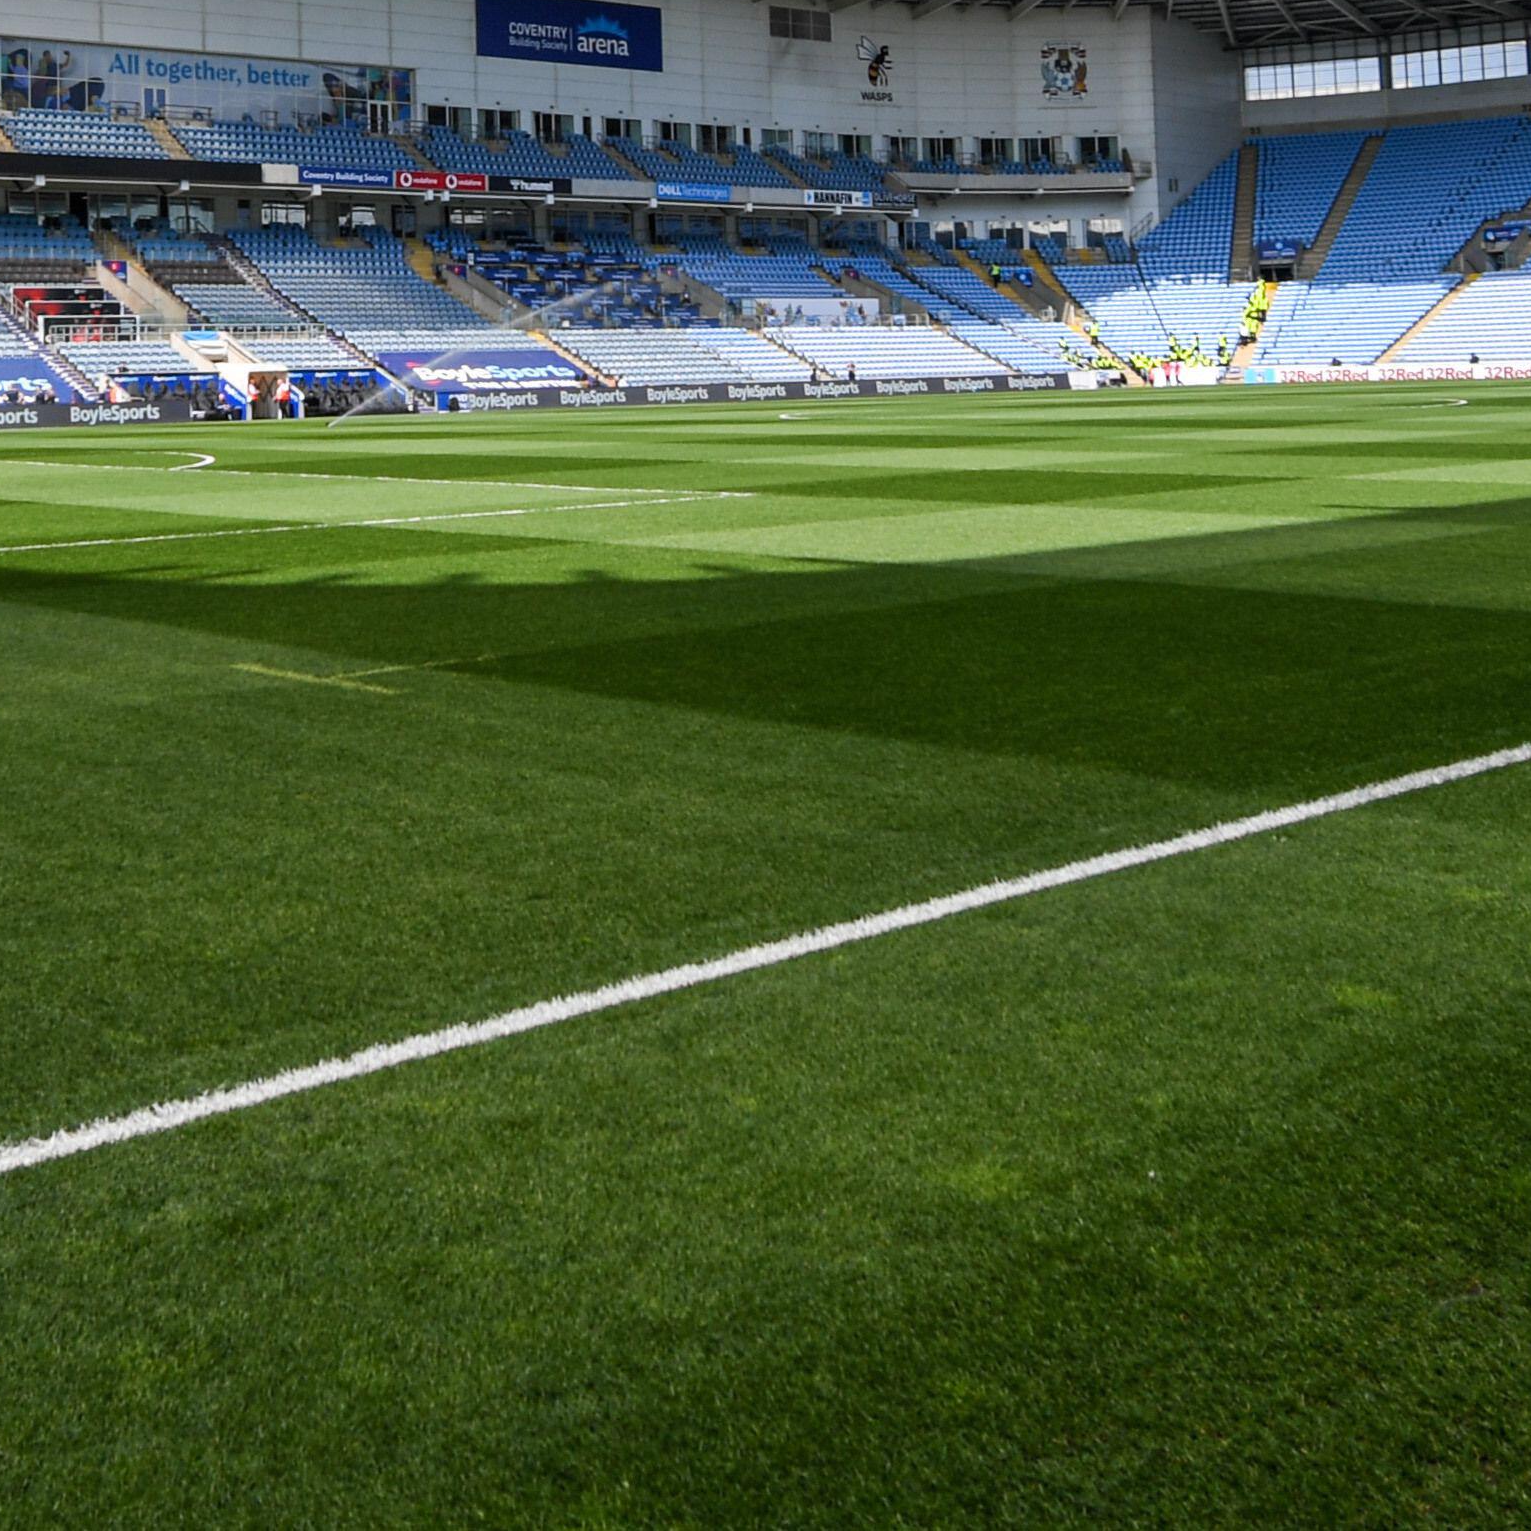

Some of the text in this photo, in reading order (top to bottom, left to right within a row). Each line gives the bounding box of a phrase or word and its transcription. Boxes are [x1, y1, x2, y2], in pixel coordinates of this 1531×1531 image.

[509, 22, 568, 39] COVENTRY
[509, 36, 568, 52] Building Society
[577, 36, 629, 56] arena
[109, 53, 310, 87] All together, better
[860, 91, 893, 102] WASPS
[303, 170, 388, 184] Coventry Building Society
[412, 177, 438, 185] vodafone
[457, 179, 482, 187] vodafone
[519, 180, 553, 192] hummel
[413, 365, 576, 384] BoyleSports
[1280, 371, 1323, 383] 32Red
[1326, 370, 1368, 382] 32Red
[1378, 369, 1424, 381] 32Red
[1426, 368, 1473, 380] 32Red
[728, 382, 786, 400] BoyleSports
[804, 381, 860, 398] BoyleSports
[876, 379, 928, 395] BoyleSports
[944, 377, 994, 392] BoyleSports
[1008, 376, 1056, 390] BoyleSports
[468, 392, 539, 409] BoyleSports
[560, 389, 626, 407] BoyleSports
[647, 387, 709, 403] BoyleSports
[71, 404, 160, 426] BoyleSports
